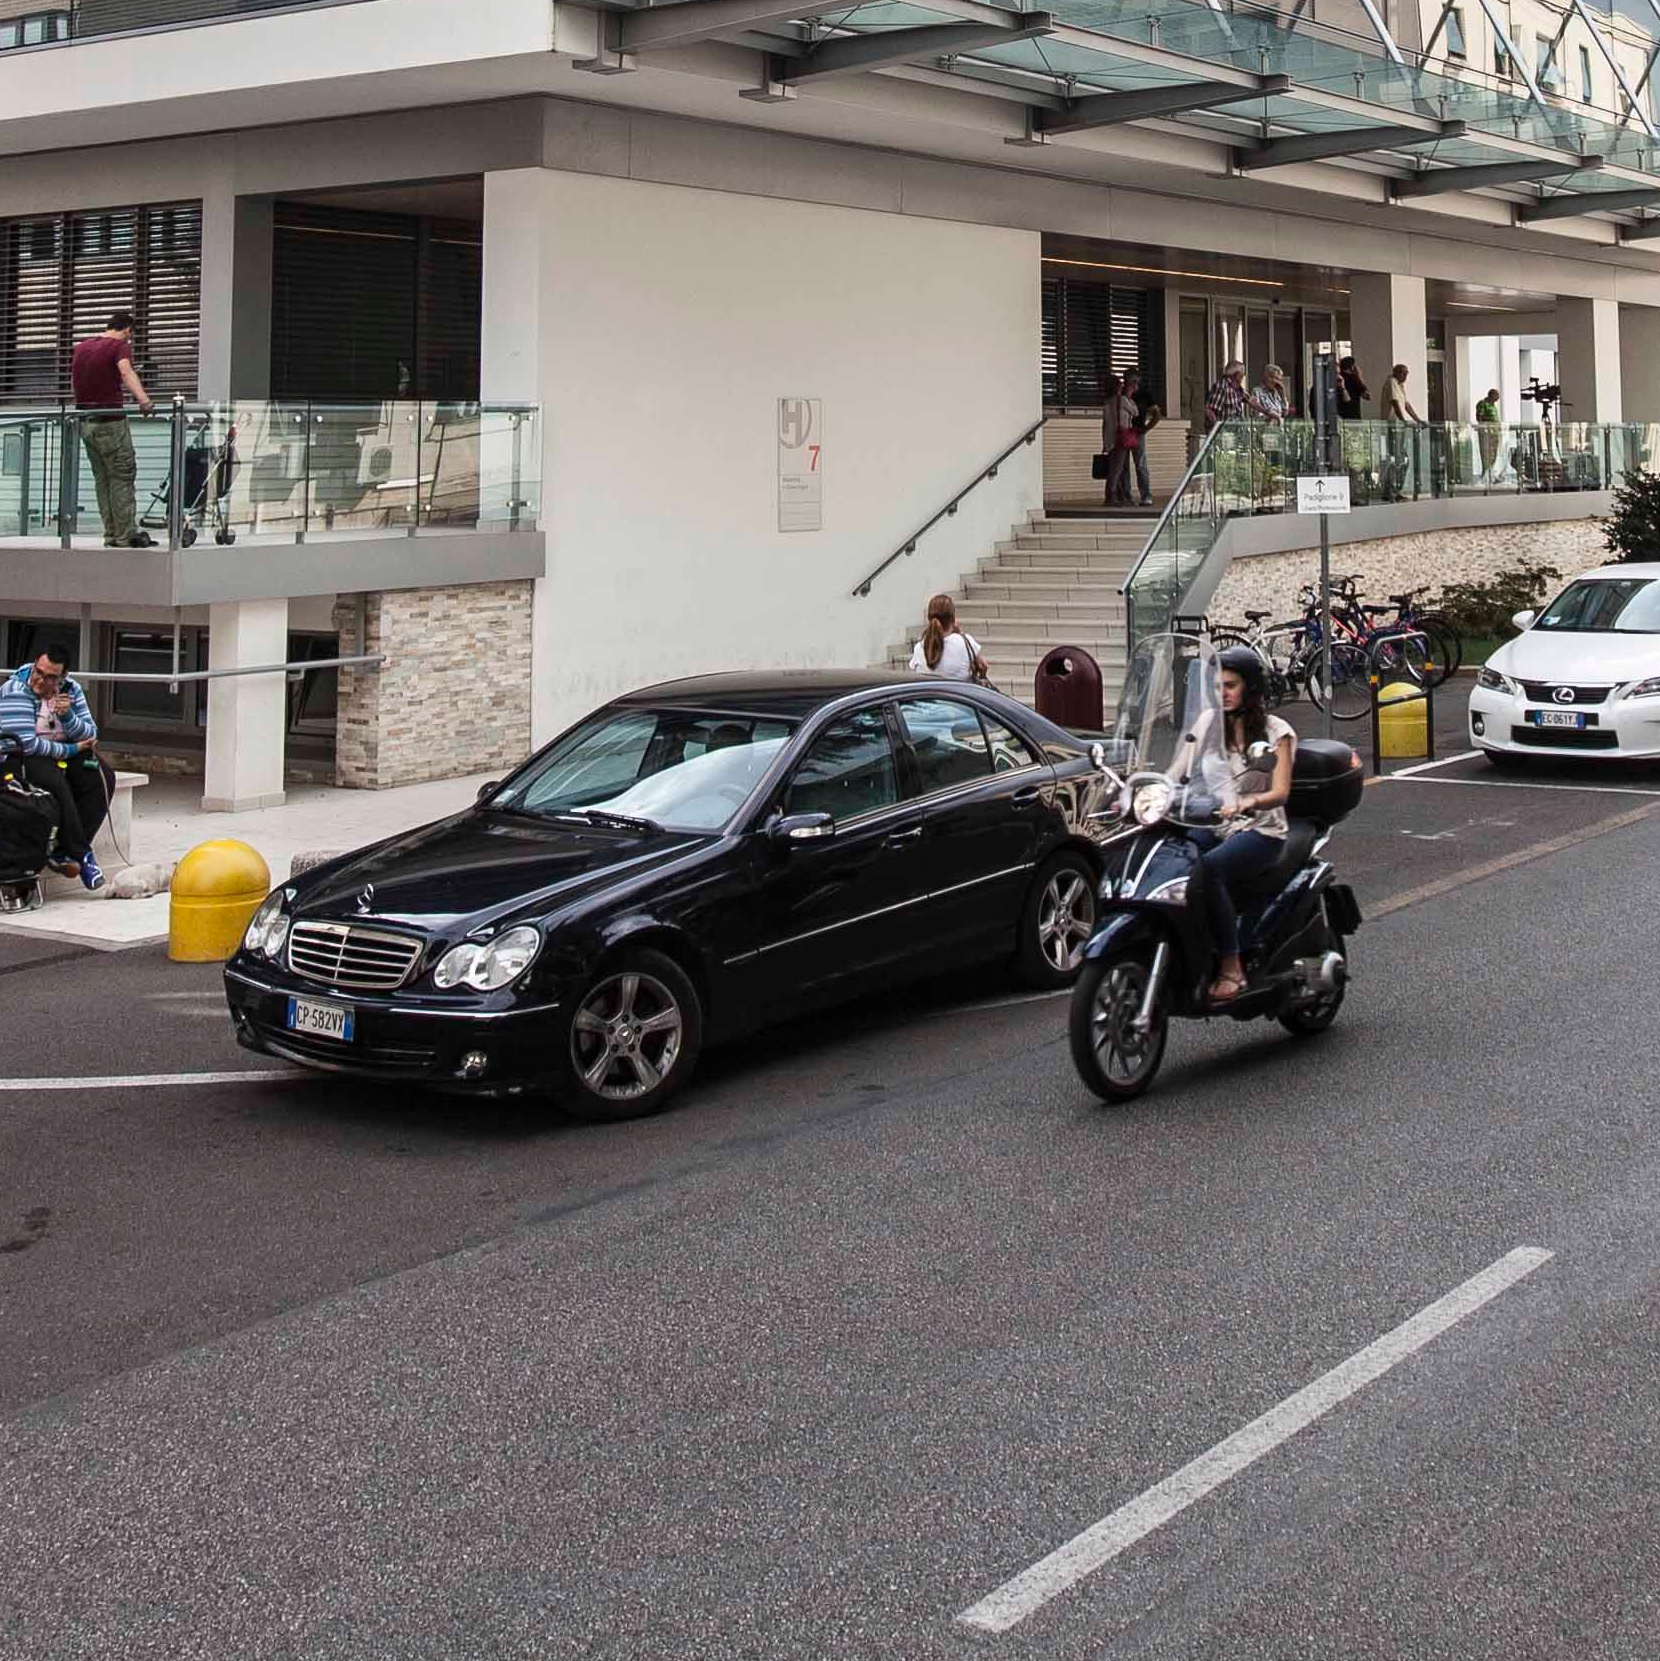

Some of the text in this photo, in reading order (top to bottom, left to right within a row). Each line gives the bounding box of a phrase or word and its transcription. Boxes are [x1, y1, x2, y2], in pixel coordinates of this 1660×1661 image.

[809, 444, 820, 472] 7
[297, 1005, 344, 1033] CP 582VX
